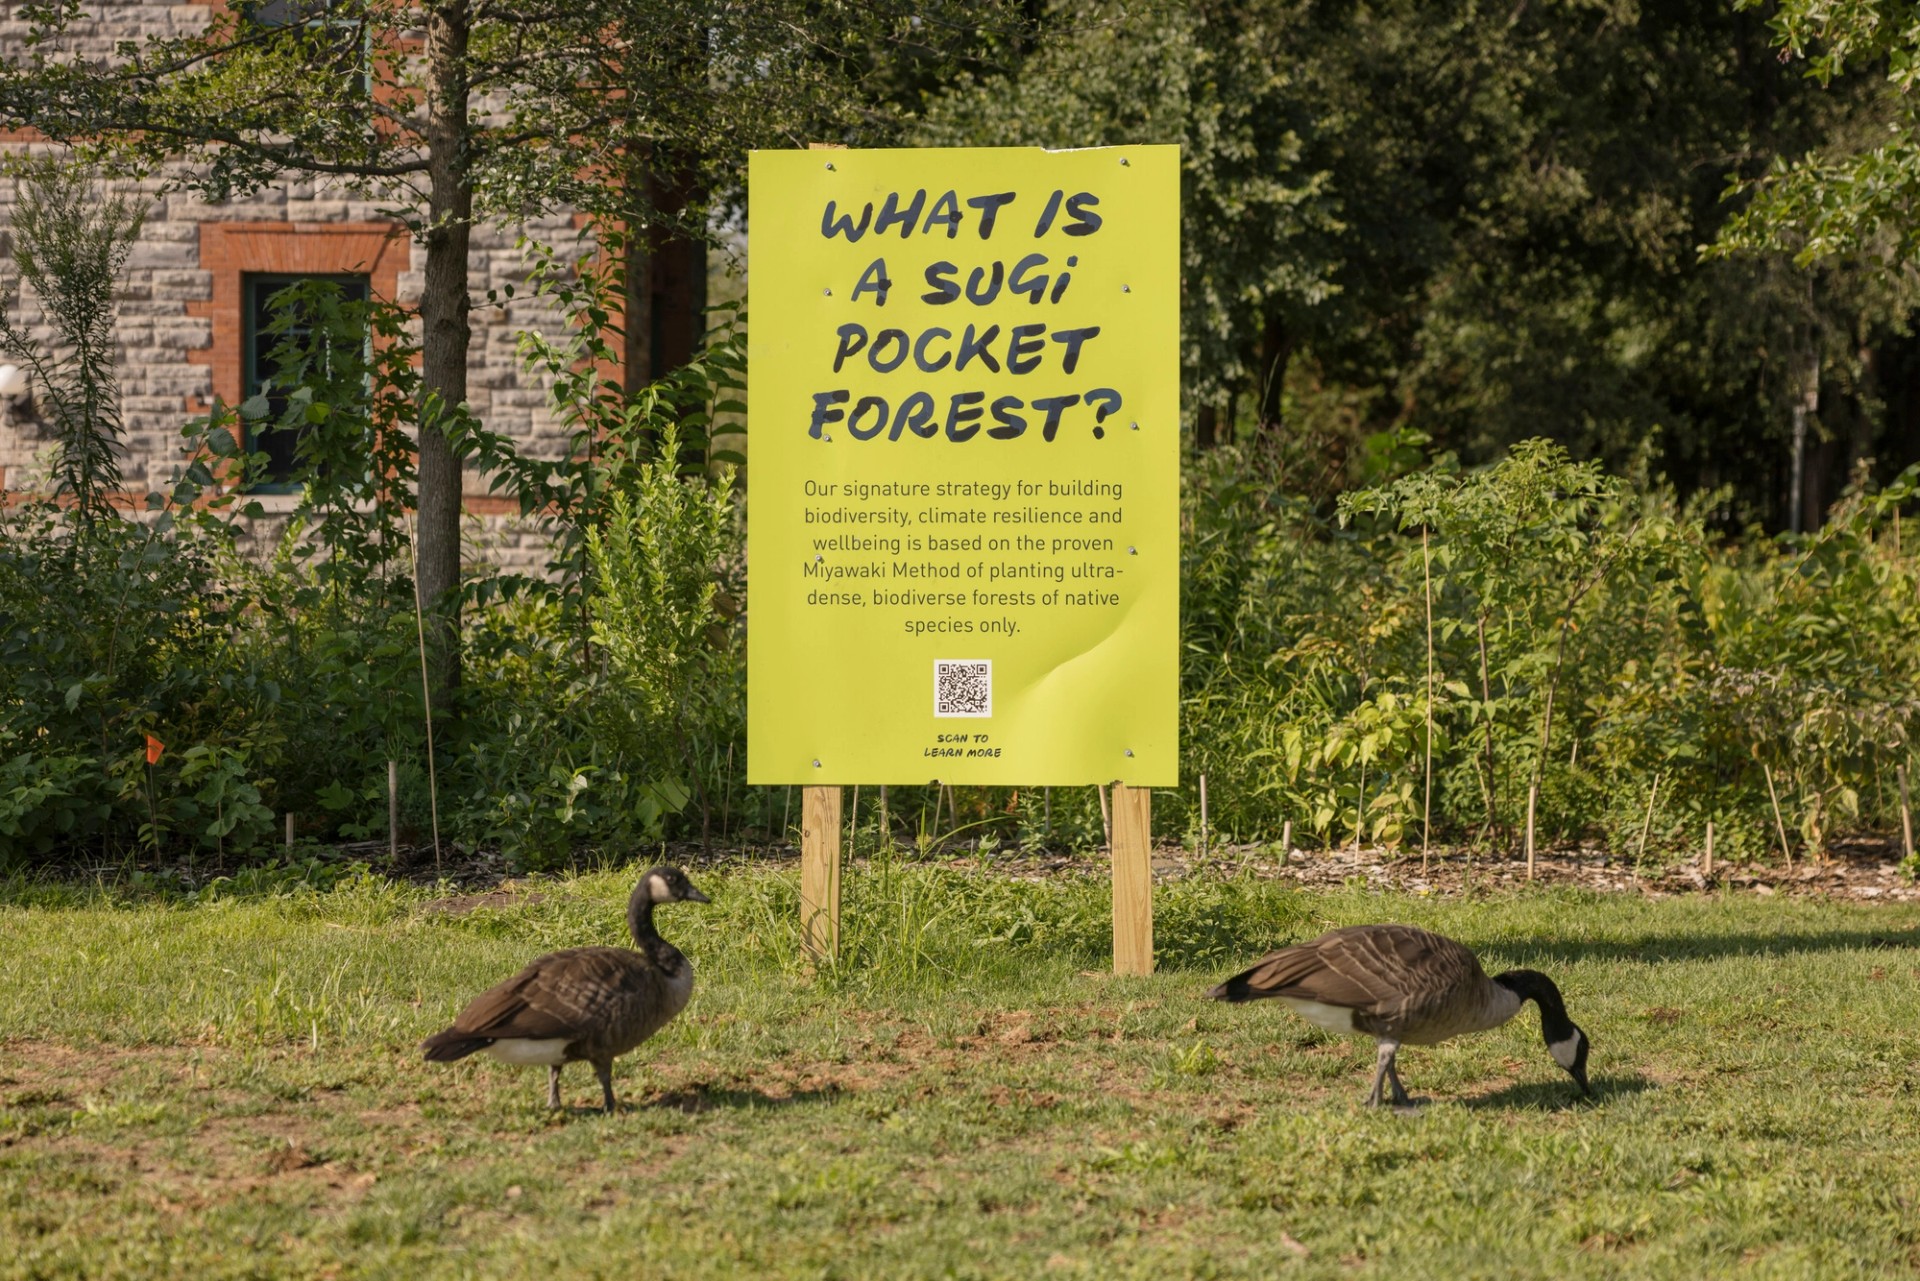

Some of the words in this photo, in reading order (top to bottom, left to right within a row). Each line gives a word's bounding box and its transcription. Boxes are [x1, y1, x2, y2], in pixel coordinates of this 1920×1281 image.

[821, 189, 1017, 243] WHAT
[1032, 190, 1104, 238] IS
[850, 258, 893, 307] A
[832, 323, 1101, 375] POCKET
[807, 388, 1123, 443] FOREST?
[804, 480, 837, 496] Our
[843, 480, 929, 500] signature
[936, 482, 1011, 500] strategy
[1016, 480, 1042, 496] for
[1049, 480, 1122, 500] building
[805, 508, 911, 527] biodiversity,
[918, 507, 986, 523] climate
[993, 507, 1082, 523] resilience
[1088, 507, 1122, 523] and
[812, 535, 900, 555] wellbeing
[907, 535, 921, 550] is
[928, 535, 981, 550] based
[988, 539, 1010, 550] on
[1016, 535, 1046, 550] the
[1052, 539, 1113, 555] proven
[803, 562, 885, 582] Miyawaki
[892, 562, 960, 578] Method
[966, 562, 983, 577] of
[990, 562, 1063, 582] planting
[1071, 562, 1123, 578] ultra-
[807, 589, 866, 607] dense,
[873, 589, 965, 605] biodiverse
[972, 589, 1035, 605] forests
[1042, 589, 1058, 605] of
[1065, 589, 1119, 605] native
[904, 616, 973, 636] species
[980, 617, 1020, 637] only.
[937, 734, 968, 743] SCAN
[973, 734, 989, 743] TO
[923, 748, 963, 757] LEARN
[966, 748, 1002, 757] MORE
